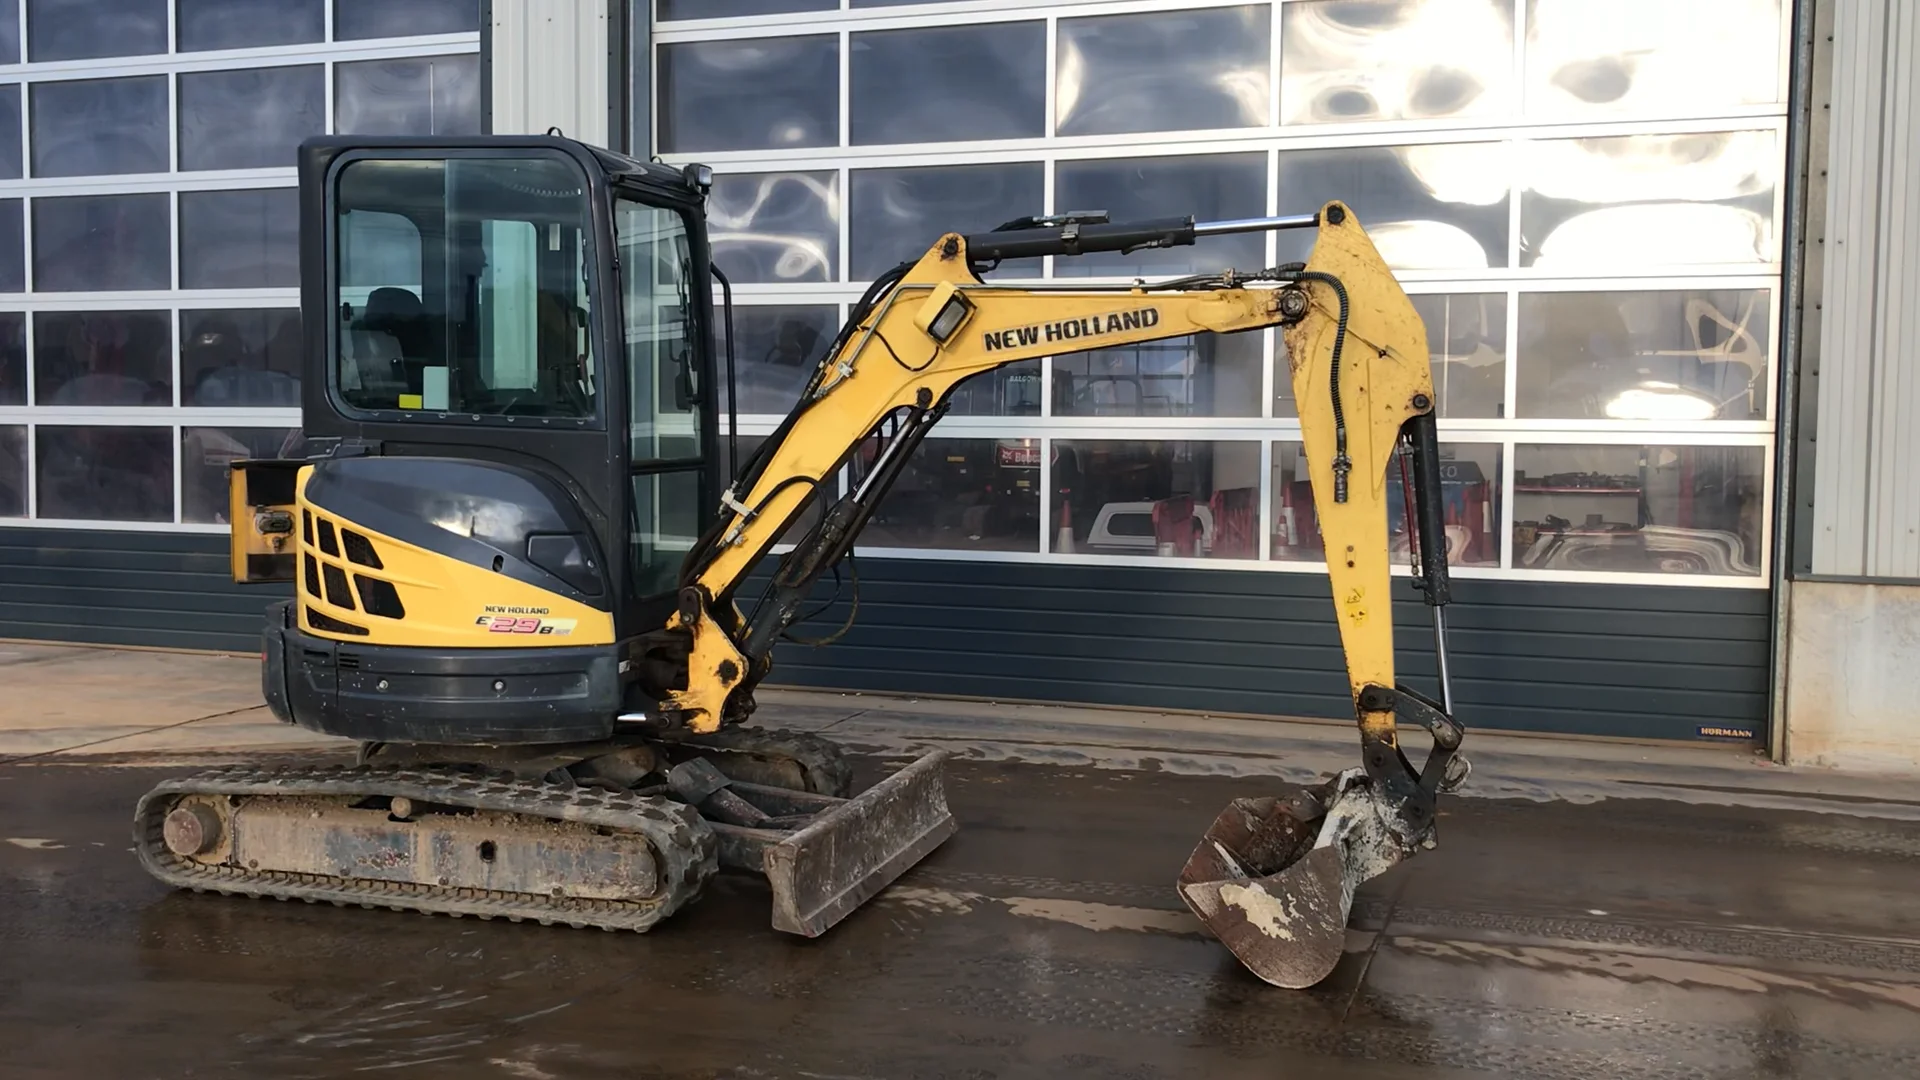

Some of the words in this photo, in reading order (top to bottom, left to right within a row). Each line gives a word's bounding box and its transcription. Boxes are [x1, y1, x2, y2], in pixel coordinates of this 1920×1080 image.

[984, 326, 1038, 352] NEW
[1045, 307, 1159, 342] HOLLAND
[485, 605, 506, 613] NEW
[508, 606, 549, 615] HOLLAND
